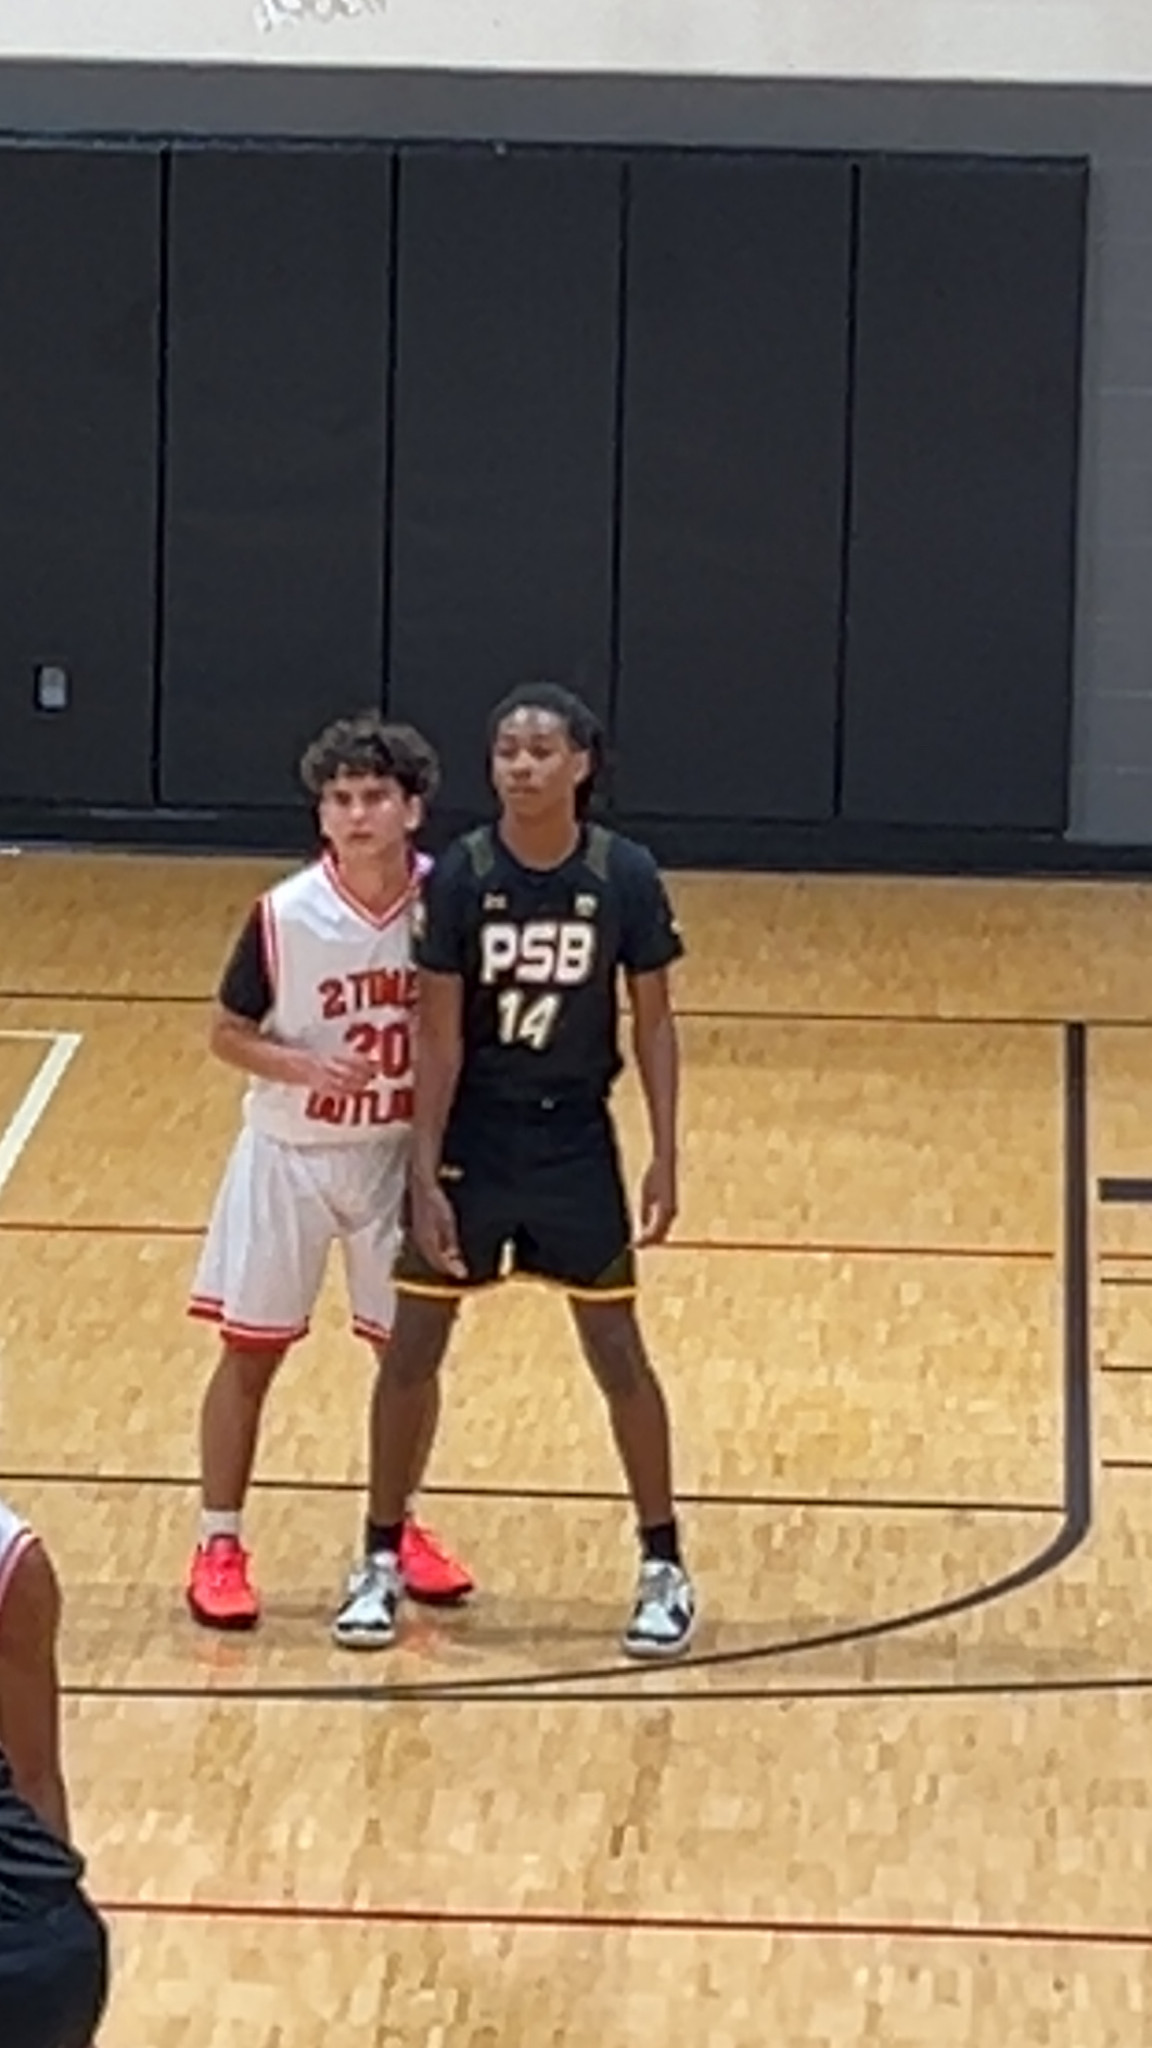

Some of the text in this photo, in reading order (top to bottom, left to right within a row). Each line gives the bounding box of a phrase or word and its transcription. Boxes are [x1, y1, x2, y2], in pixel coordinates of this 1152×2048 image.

[480, 922, 594, 985] PSB
[318, 978, 347, 1019] 2
[498, 988, 561, 1049] 14
